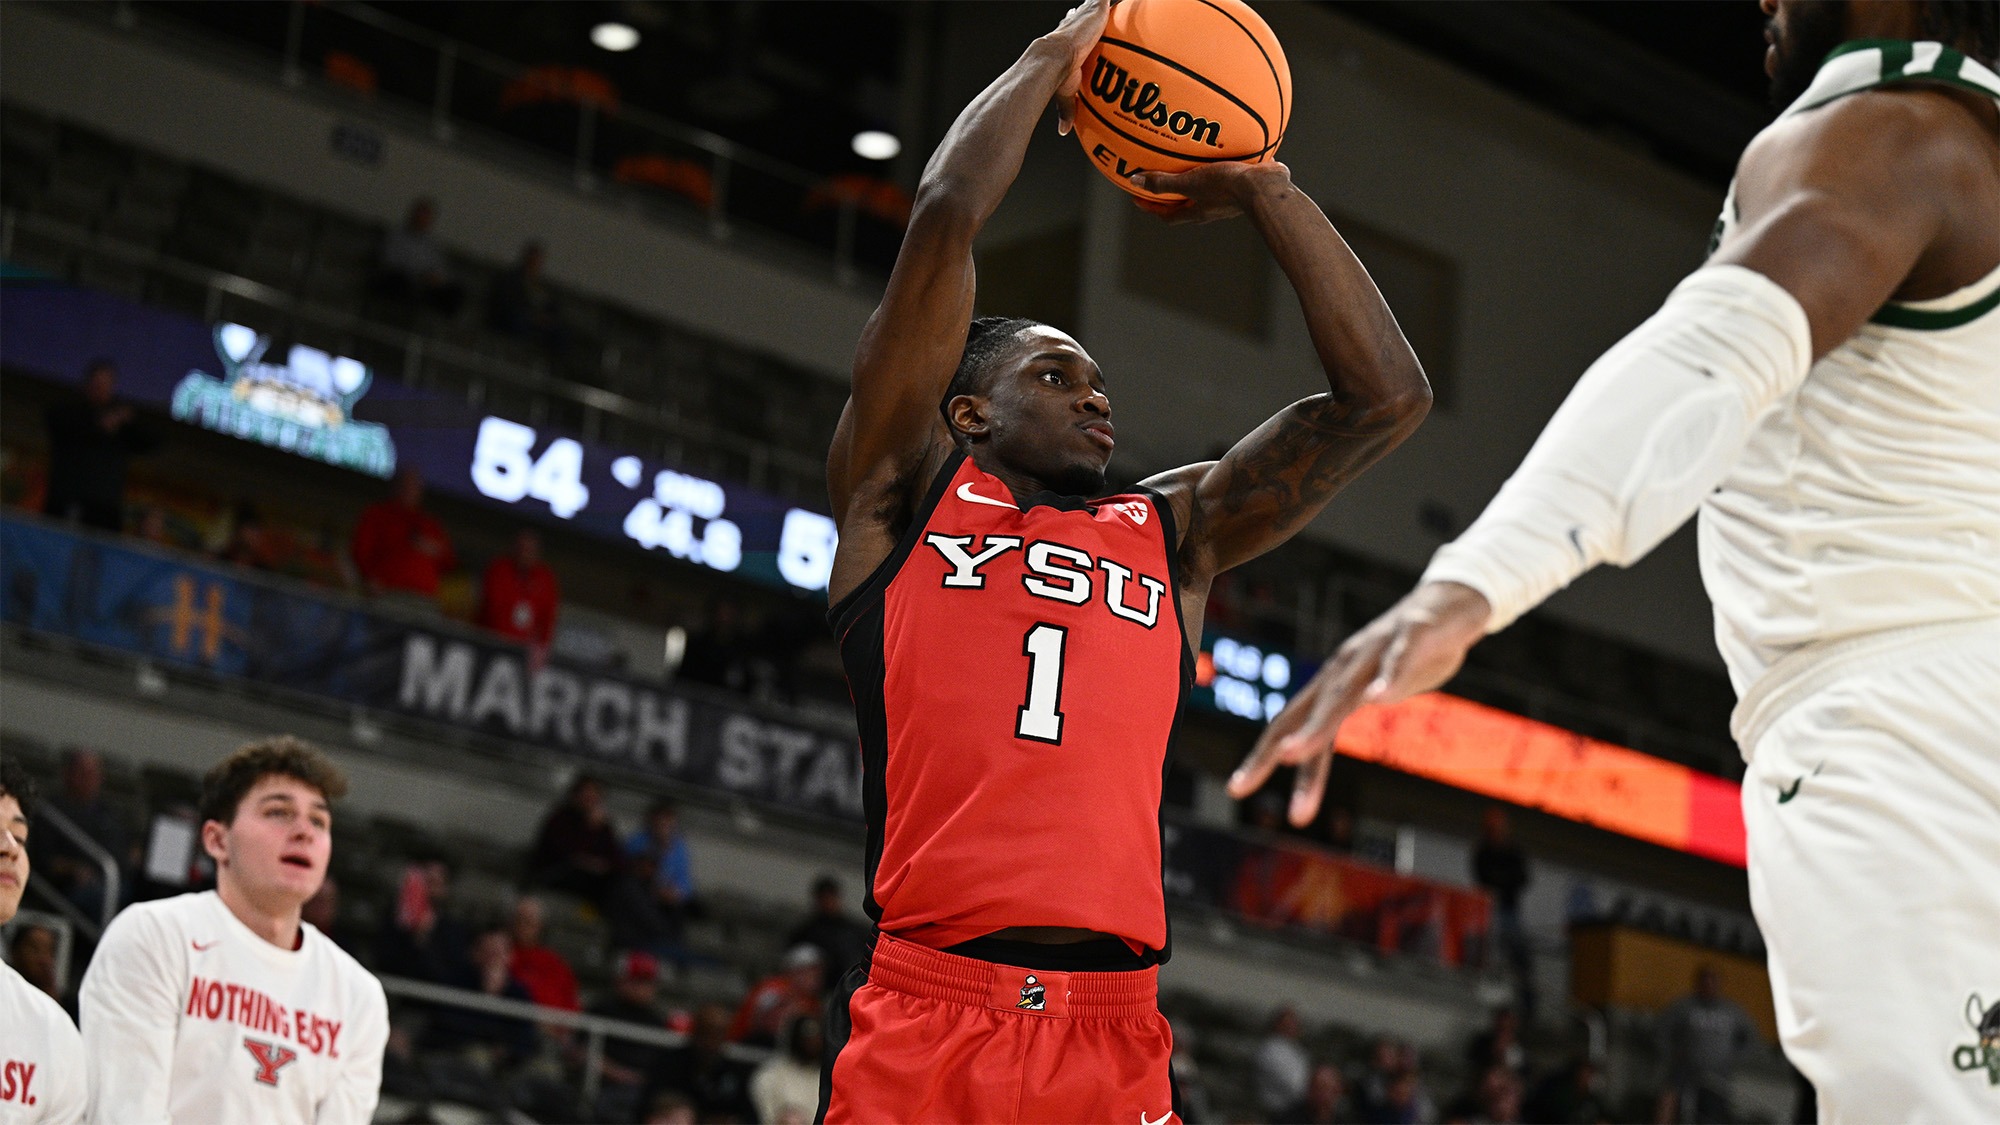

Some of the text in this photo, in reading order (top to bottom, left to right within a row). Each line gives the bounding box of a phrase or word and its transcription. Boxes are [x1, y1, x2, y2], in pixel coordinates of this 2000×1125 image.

[1092, 143, 1145, 179] EV
[1160, 132, 1179, 142] BALL
[471, 415, 590, 519] 54
[777, 507, 839, 591] 5
[923, 531, 1167, 630] YSU
[401, 631, 863, 814] MARCH STA
[1014, 621, 1068, 746] 1
[243, 1037, 297, 1087] Y
